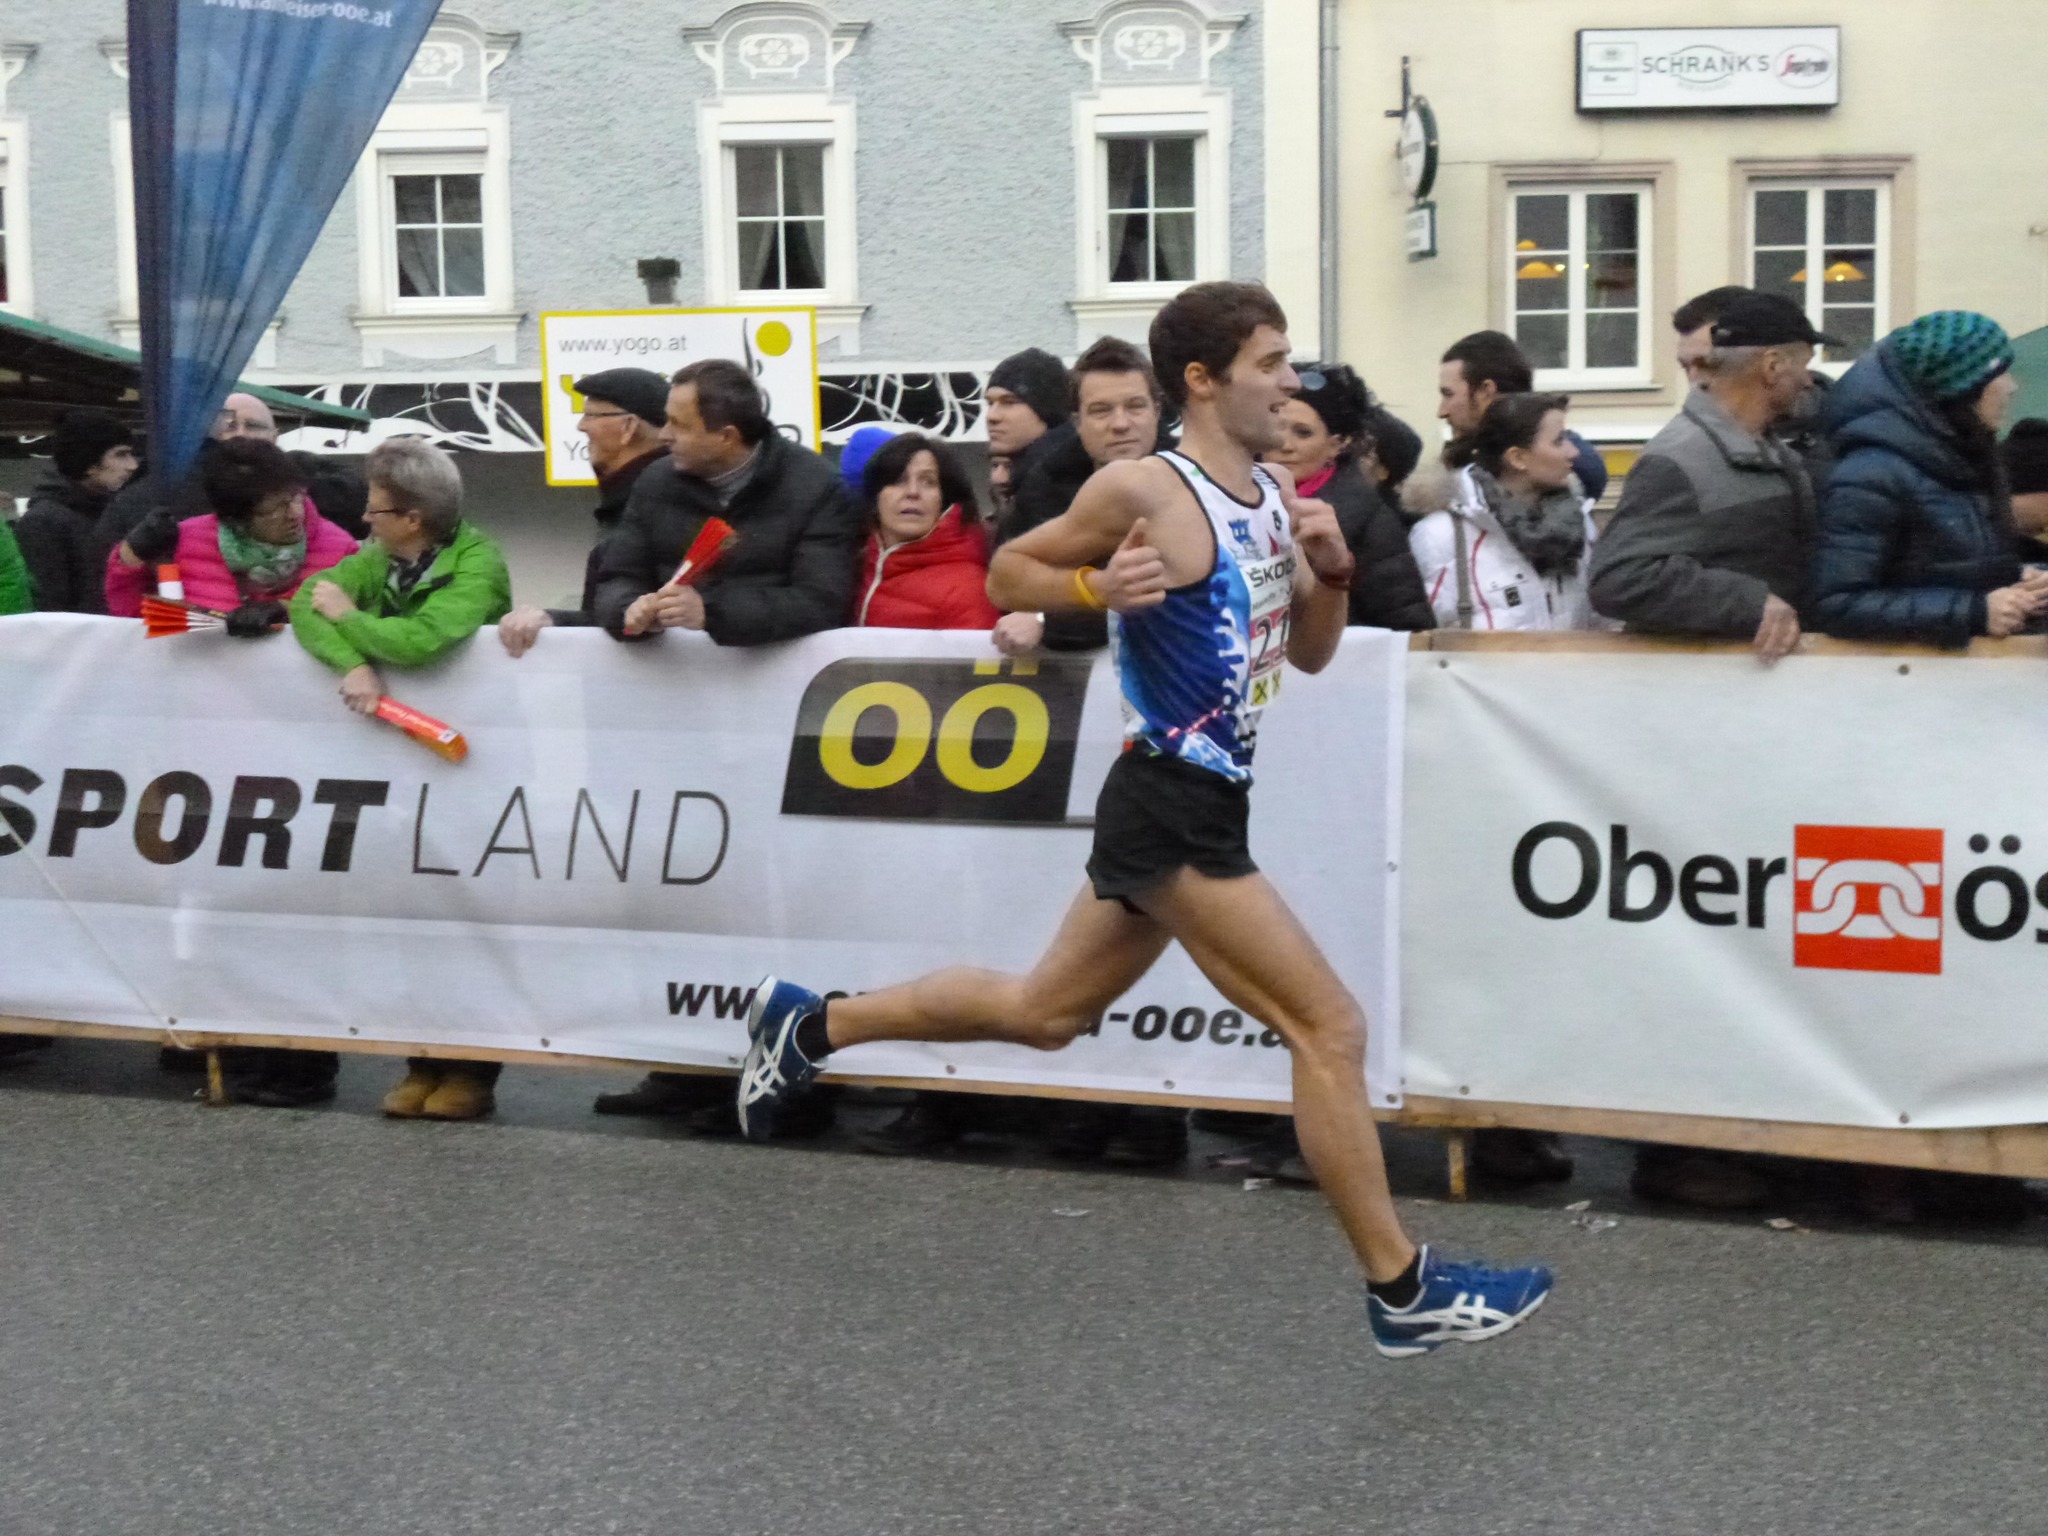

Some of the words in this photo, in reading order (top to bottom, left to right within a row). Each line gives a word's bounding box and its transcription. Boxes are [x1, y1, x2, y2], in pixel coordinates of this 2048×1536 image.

[558, 335, 687, 356] www.yogo.at
[1250, 556, 1297, 588] ŠKOD
[1511, 820, 1788, 929] Ober
